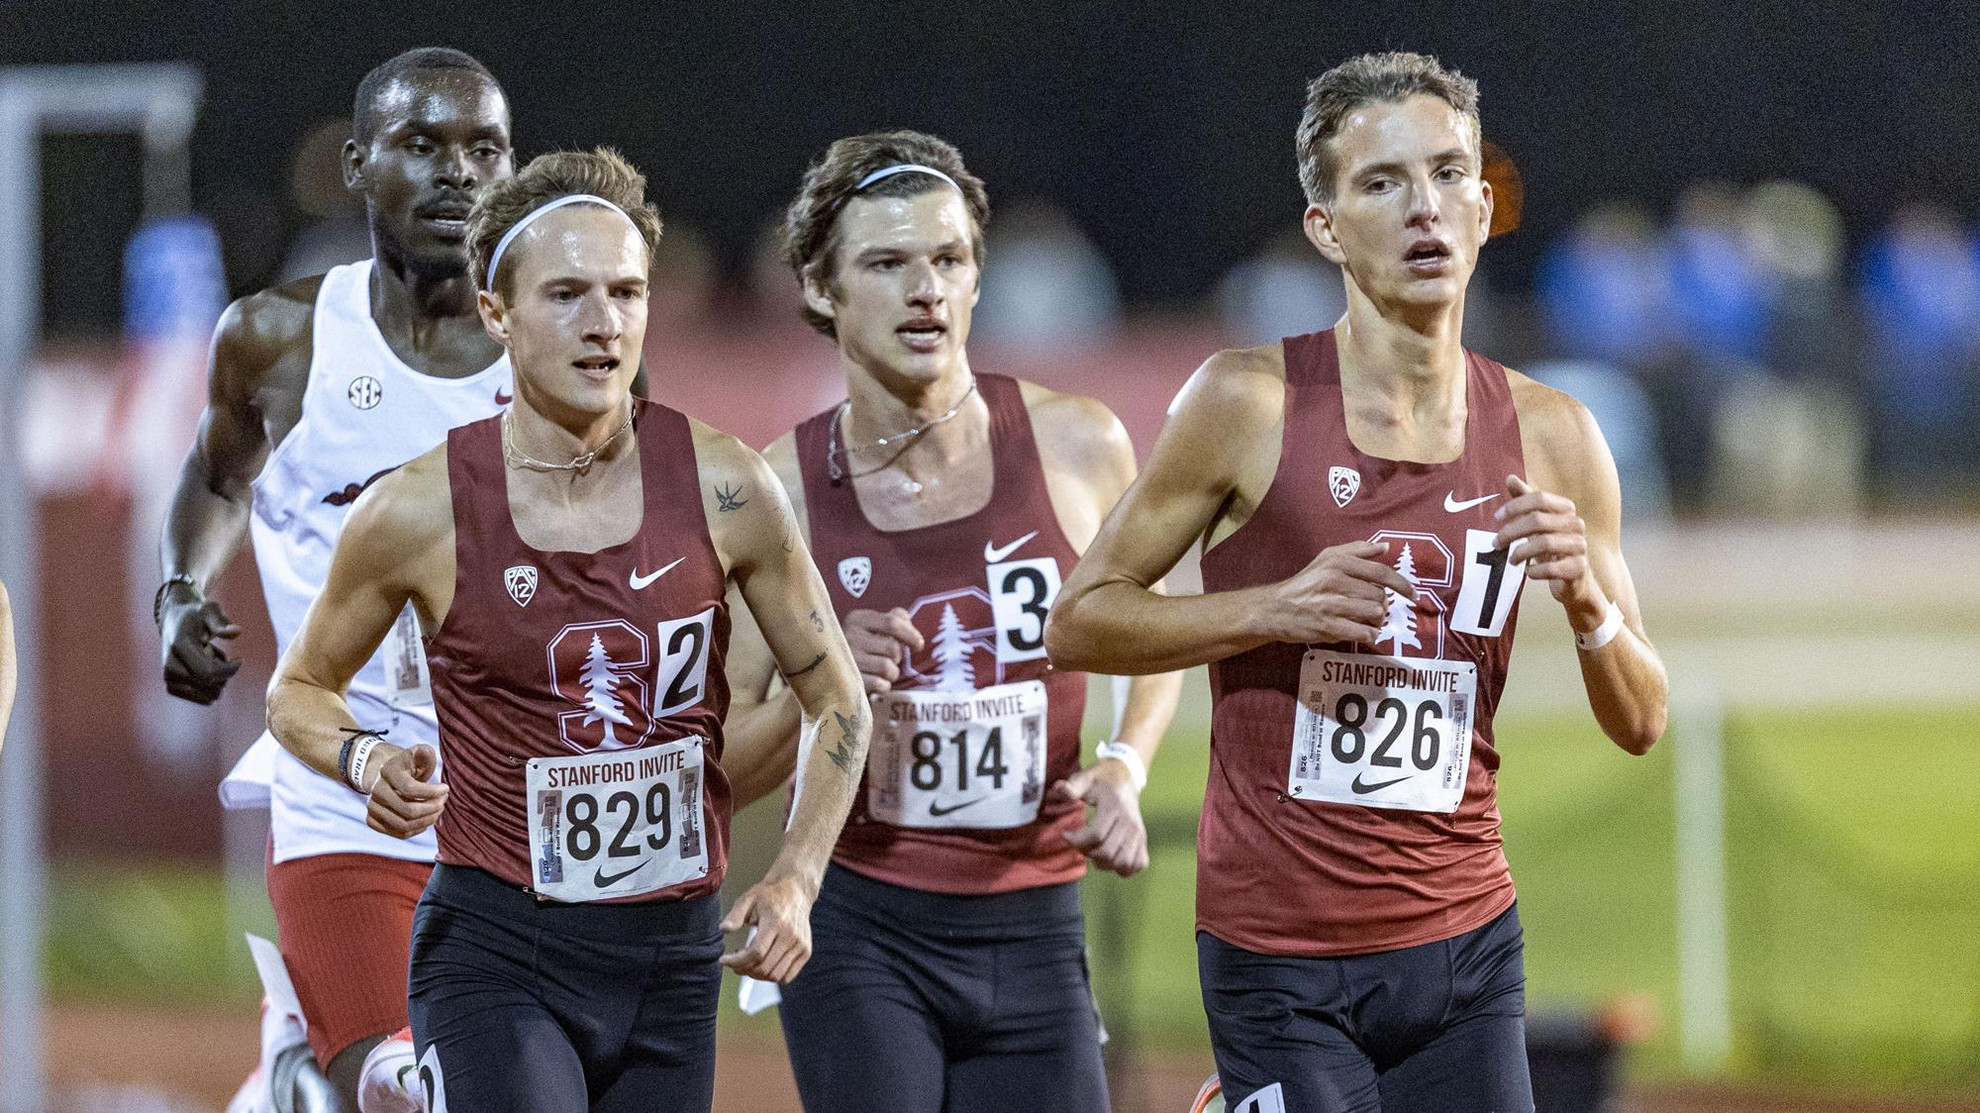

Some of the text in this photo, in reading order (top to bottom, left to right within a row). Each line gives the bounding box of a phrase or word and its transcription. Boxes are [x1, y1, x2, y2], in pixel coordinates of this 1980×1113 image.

[348, 377, 382, 410] SEC
[1331, 468, 1359, 493] PAC
[1335, 483, 1351, 500] 12
[507, 567, 537, 591] PAC
[514, 583, 531, 599] 12
[1476, 545, 1511, 630] 1
[1002, 566, 1049, 651] 3
[661, 621, 705, 711] 2
[1322, 660, 1460, 694] STANFORD INVITE
[889, 694, 1026, 723] STANFORD INVITE
[1330, 692, 1444, 772] 826
[548, 749, 685, 788] STANFORD INVITE
[911, 725, 1009, 791] 814
[565, 782, 672, 862] 829
